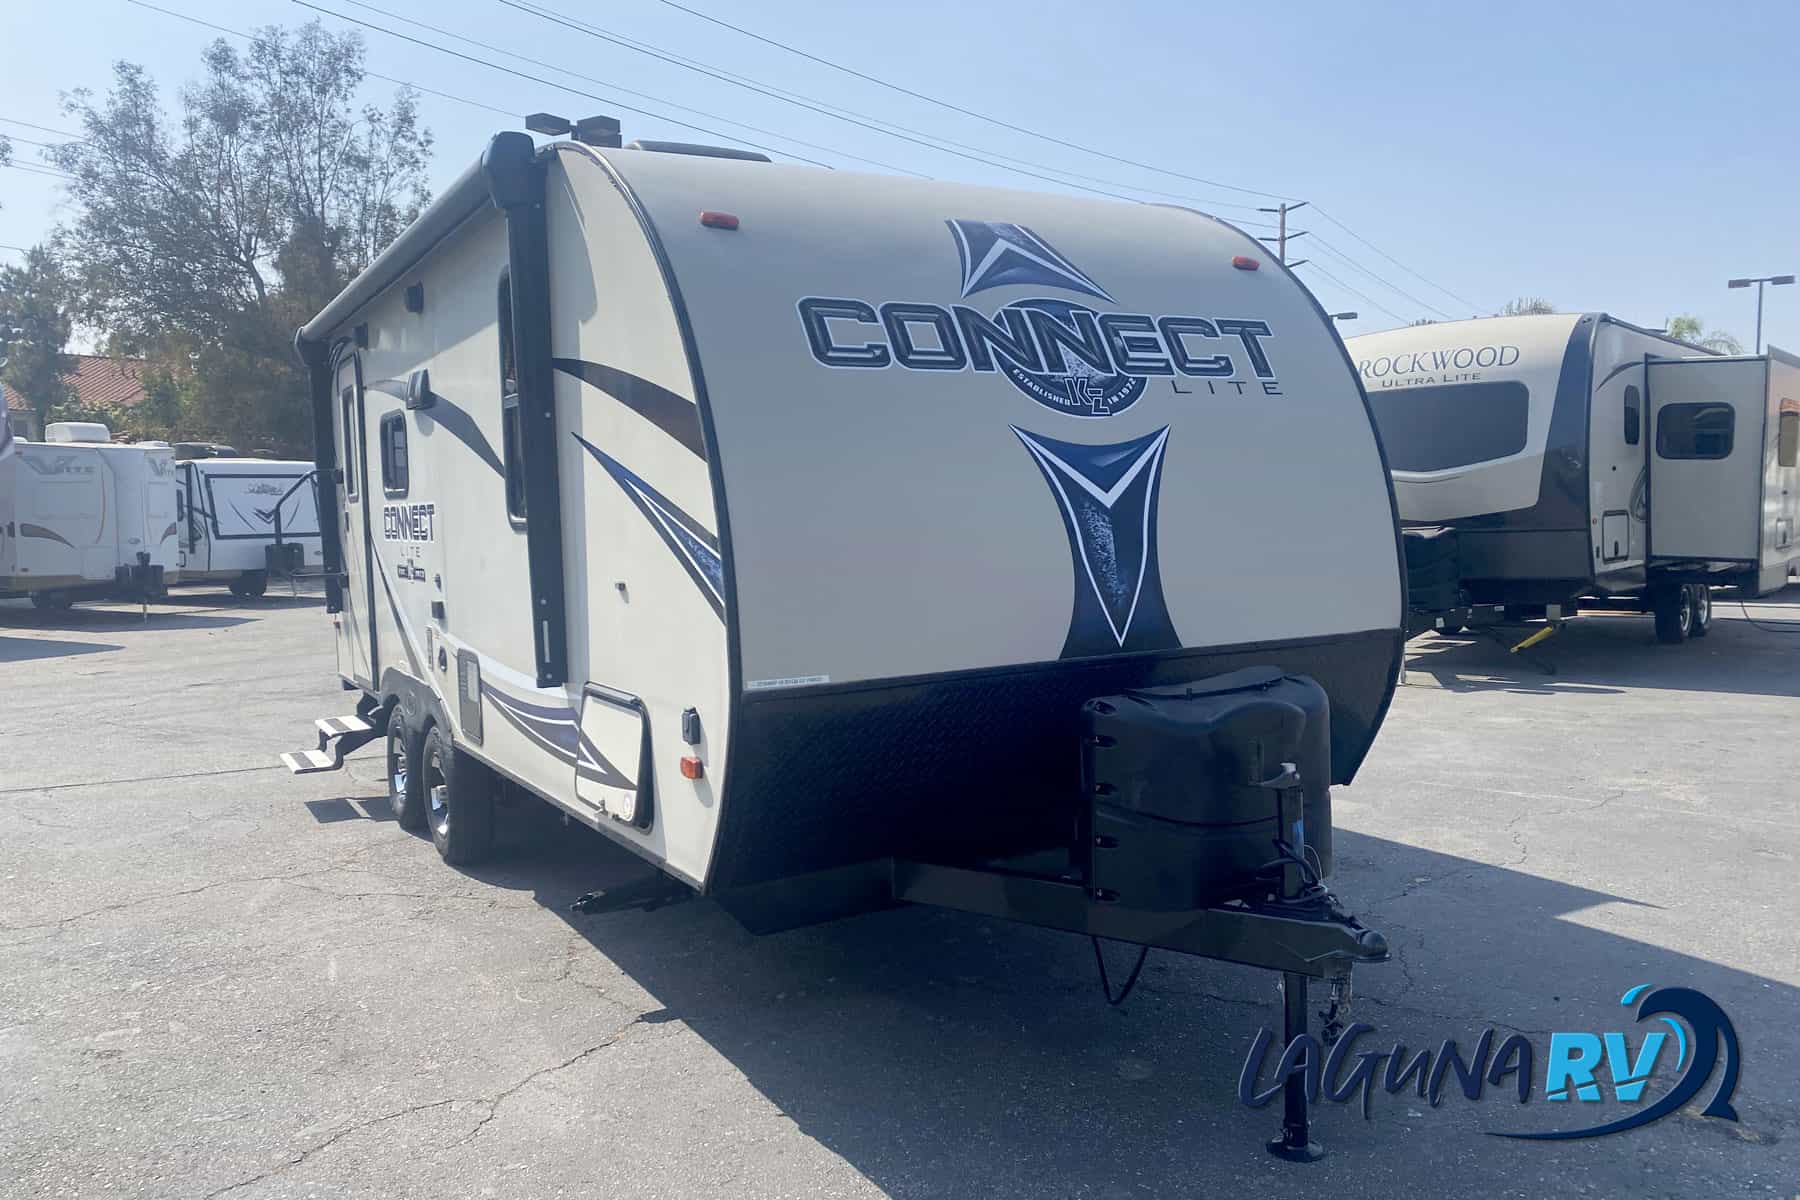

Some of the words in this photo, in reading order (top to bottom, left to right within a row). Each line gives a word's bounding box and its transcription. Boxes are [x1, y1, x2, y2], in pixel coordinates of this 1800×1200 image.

[795, 296, 1275, 379] CONNECT
[1357, 345, 1520, 379] ROCKWOOD
[1013, 369, 1071, 406] ESTABLISHED
[1117, 377, 1137, 399] 1972
[1173, 380, 1283, 395] LITE
[1382, 377, 1435, 388] ULTRA
[1443, 372, 1481, 384] LITE
[383, 503, 435, 542] CONNECT
